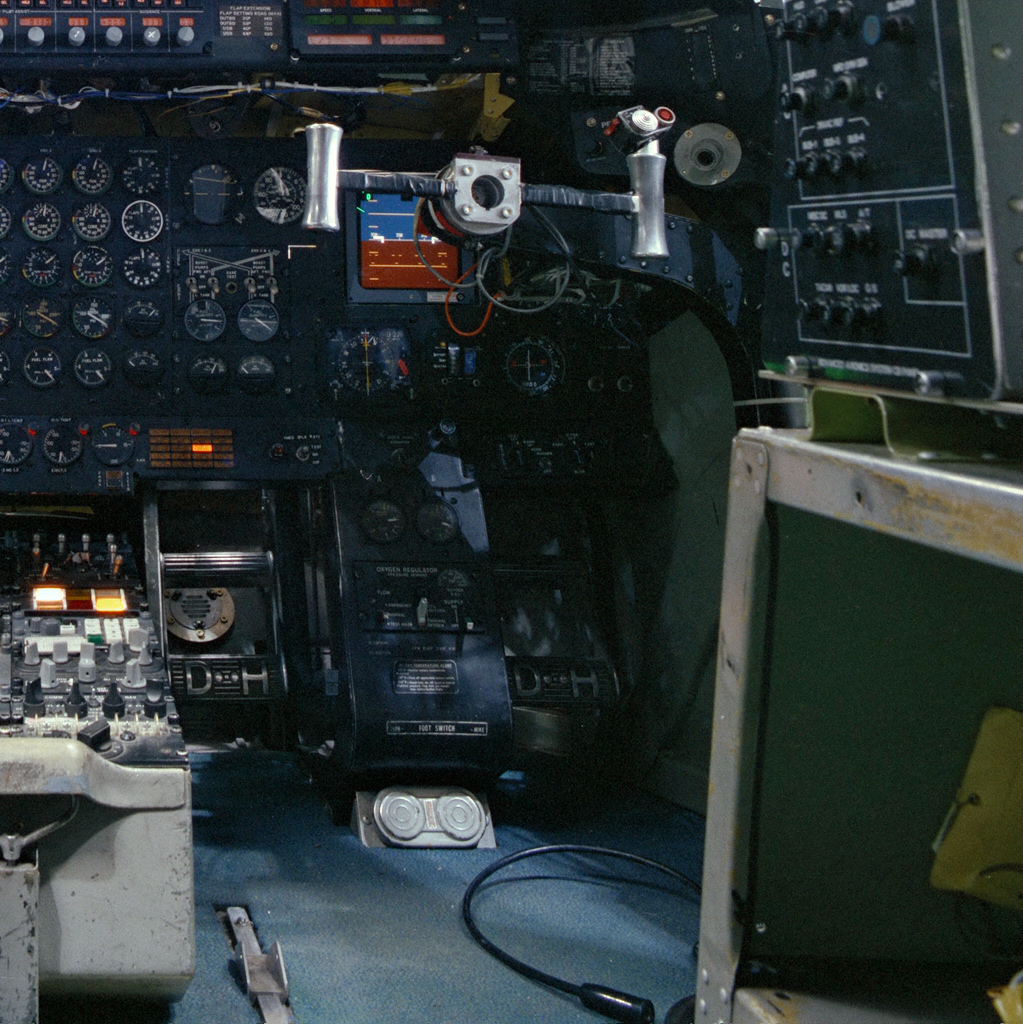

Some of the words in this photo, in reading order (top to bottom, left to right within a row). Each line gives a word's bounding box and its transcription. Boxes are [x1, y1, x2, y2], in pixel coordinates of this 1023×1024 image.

[185, 660, 212, 695] D
[241, 661, 269, 696] H
[514, 666, 541, 696] D
[570, 670, 598, 698] H
[418, 724, 433, 732] FOOT
[435, 724, 456, 732] SWITCH
